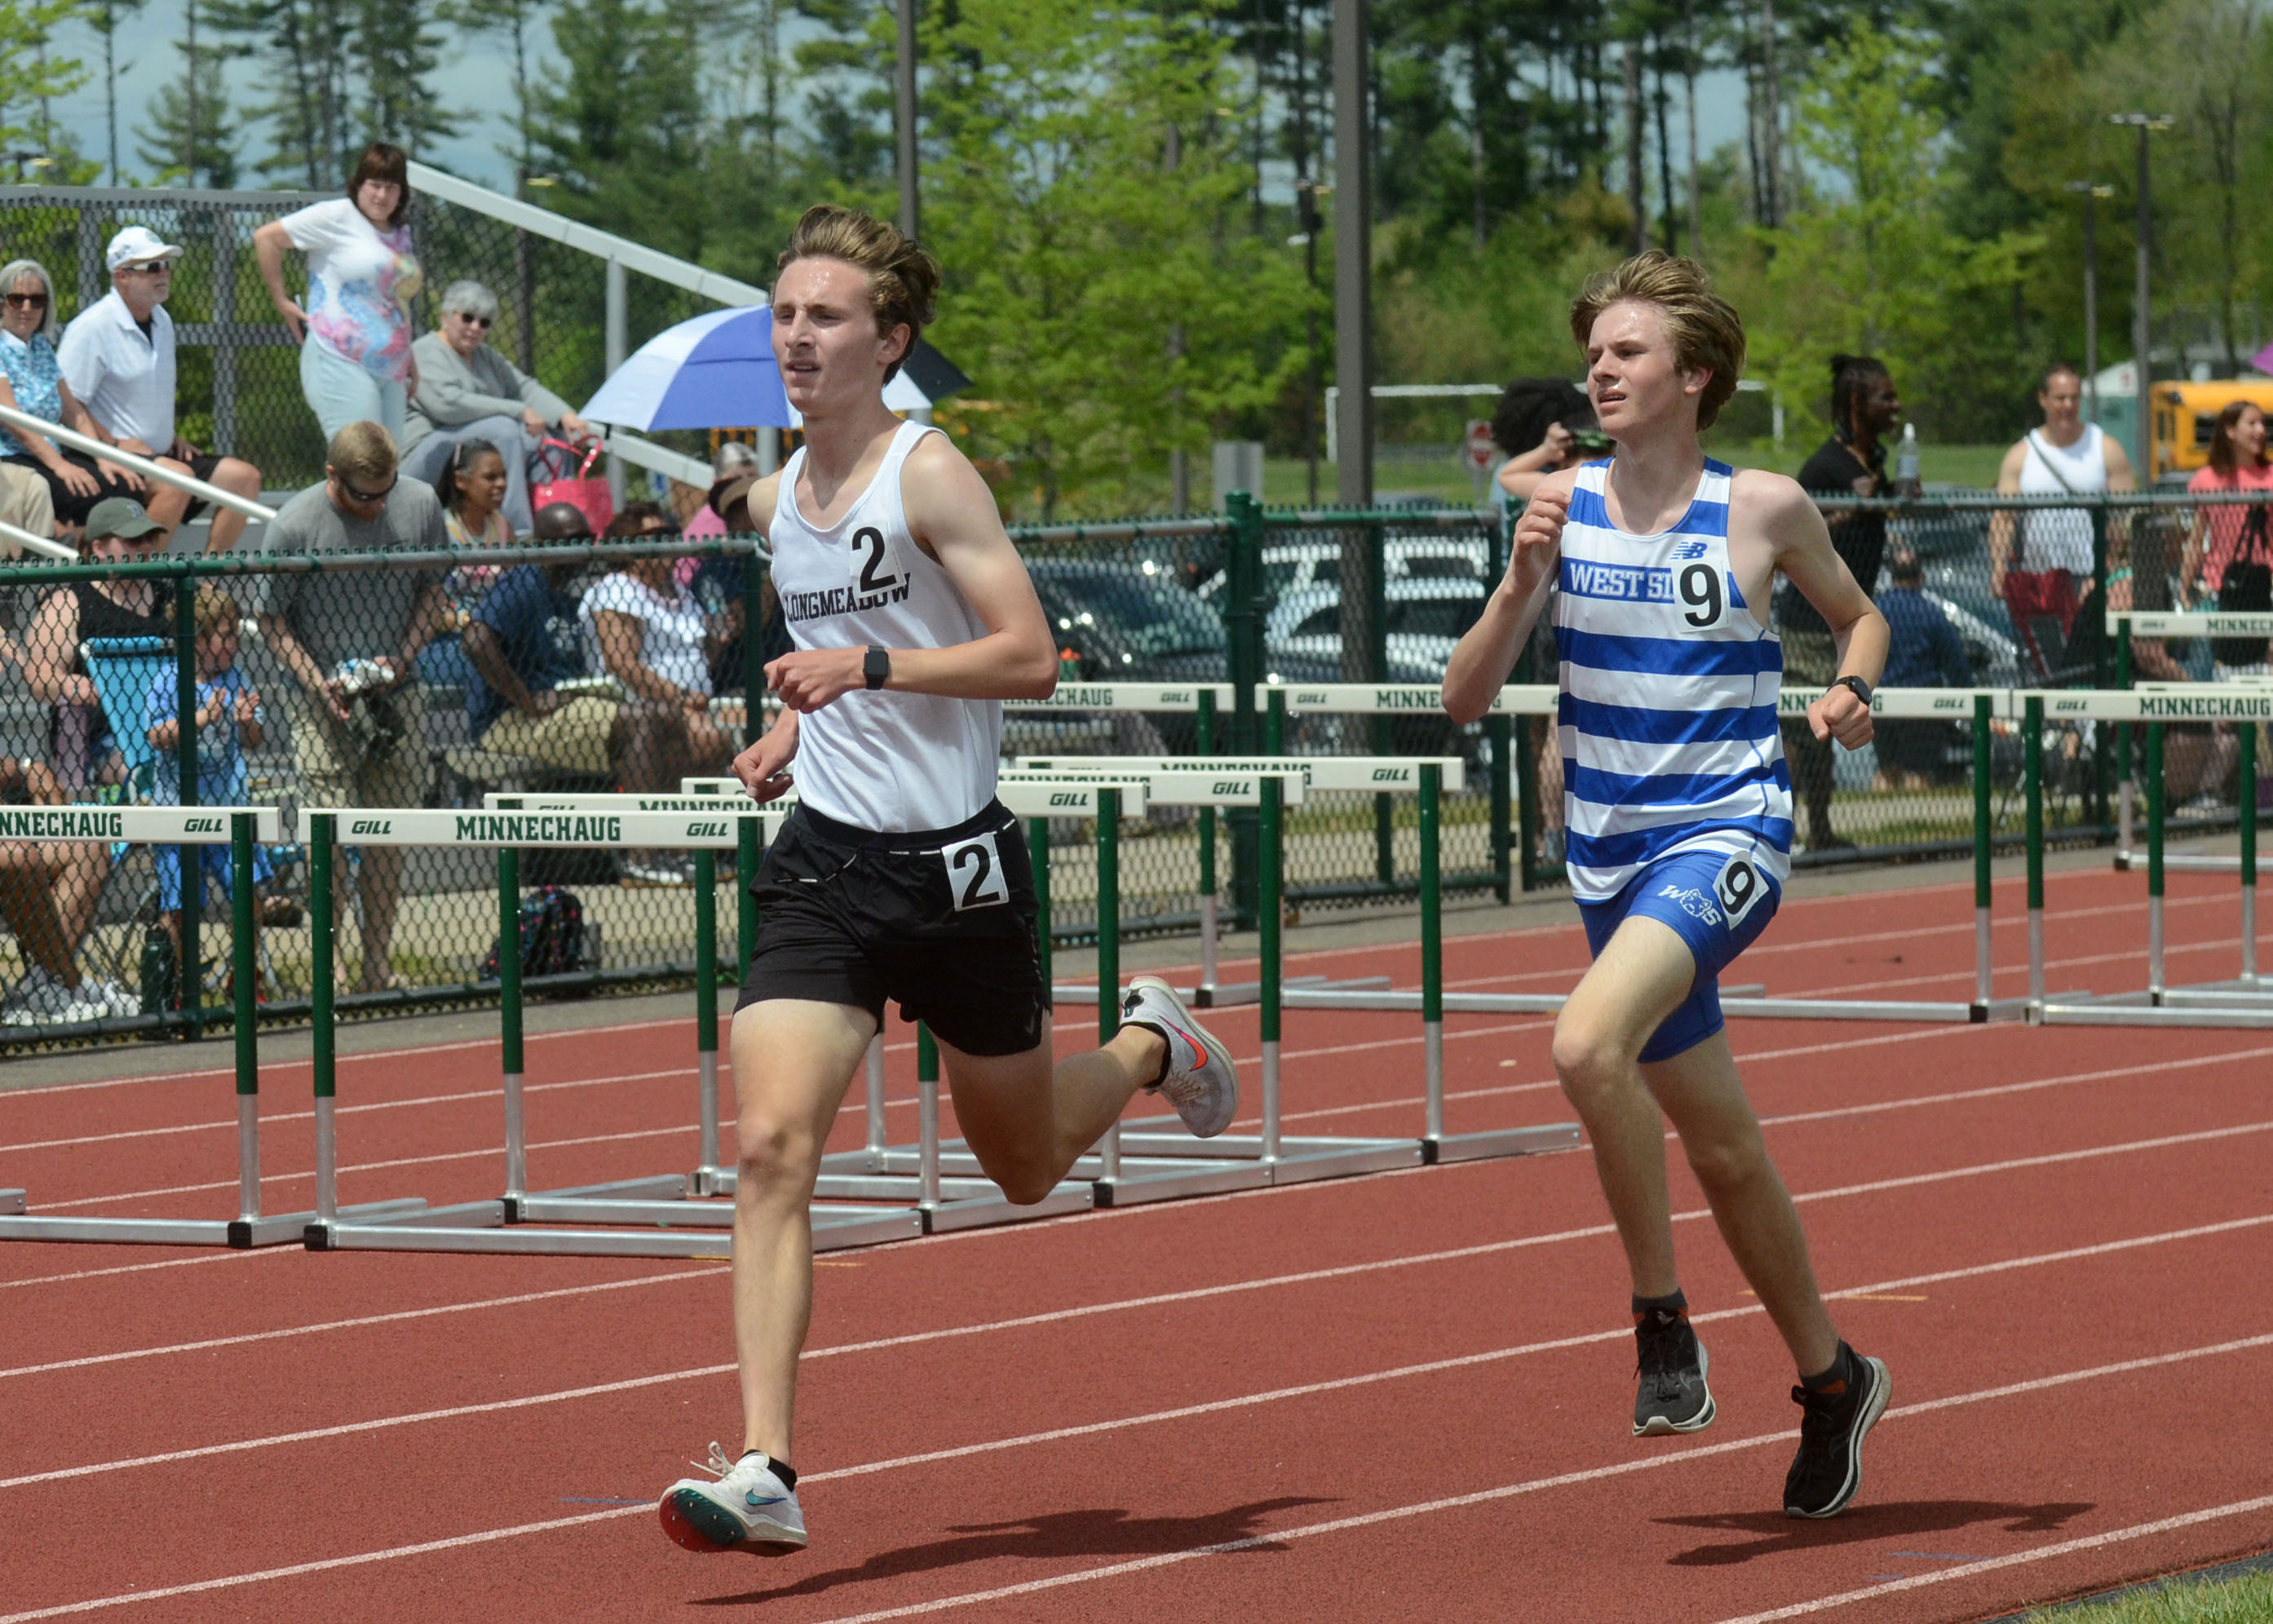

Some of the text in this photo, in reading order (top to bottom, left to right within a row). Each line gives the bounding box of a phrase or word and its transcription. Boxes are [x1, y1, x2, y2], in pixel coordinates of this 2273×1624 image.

[851, 527, 897, 592] 2
[1570, 562, 1645, 598] WEST
[1679, 564, 1722, 627] 9
[785, 573, 911, 623] LONGMEADOW
[2139, 697, 2271, 716] MINNECHAUG
[1212, 781, 1251, 794] GILL
[1371, 769, 1410, 782] GILL
[1049, 793, 1089, 807] GILL
[0, 812, 223, 837] NNECHAUG GILL
[351, 816, 729, 842] GILL MINNECHAUG GILL
[953, 843, 1001, 908] 2
[1719, 861, 1756, 915] 9
